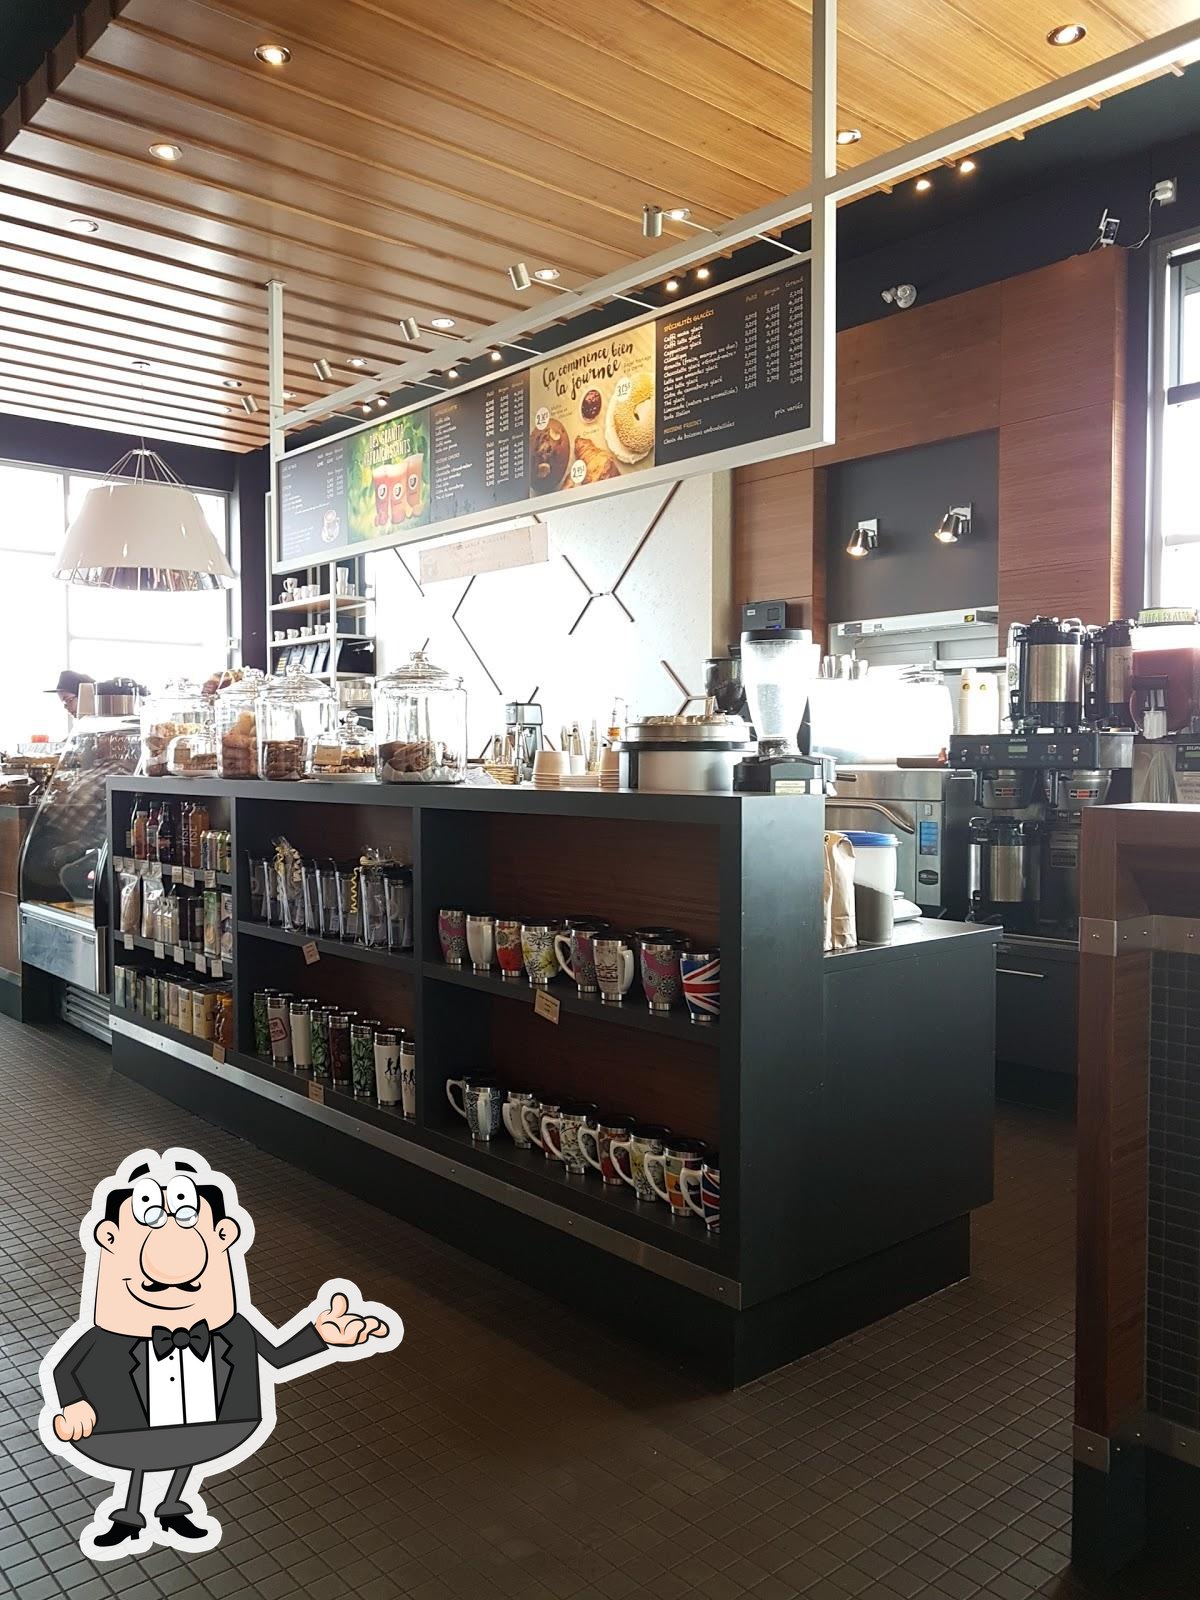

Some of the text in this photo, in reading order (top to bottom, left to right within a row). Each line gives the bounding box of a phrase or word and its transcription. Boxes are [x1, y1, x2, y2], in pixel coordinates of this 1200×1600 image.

[690, 323, 703, 335] glacé
[688, 331, 701, 343] glacé
[689, 338, 702, 350] glacé
[543, 342, 633, 392] Ça commence bien
[705, 362, 718, 373] glacé
[556, 358, 620, 401] la journée
[686, 376, 698, 387] glacé
[710, 376, 722, 387] glacé
[673, 395, 685, 405] glacé
